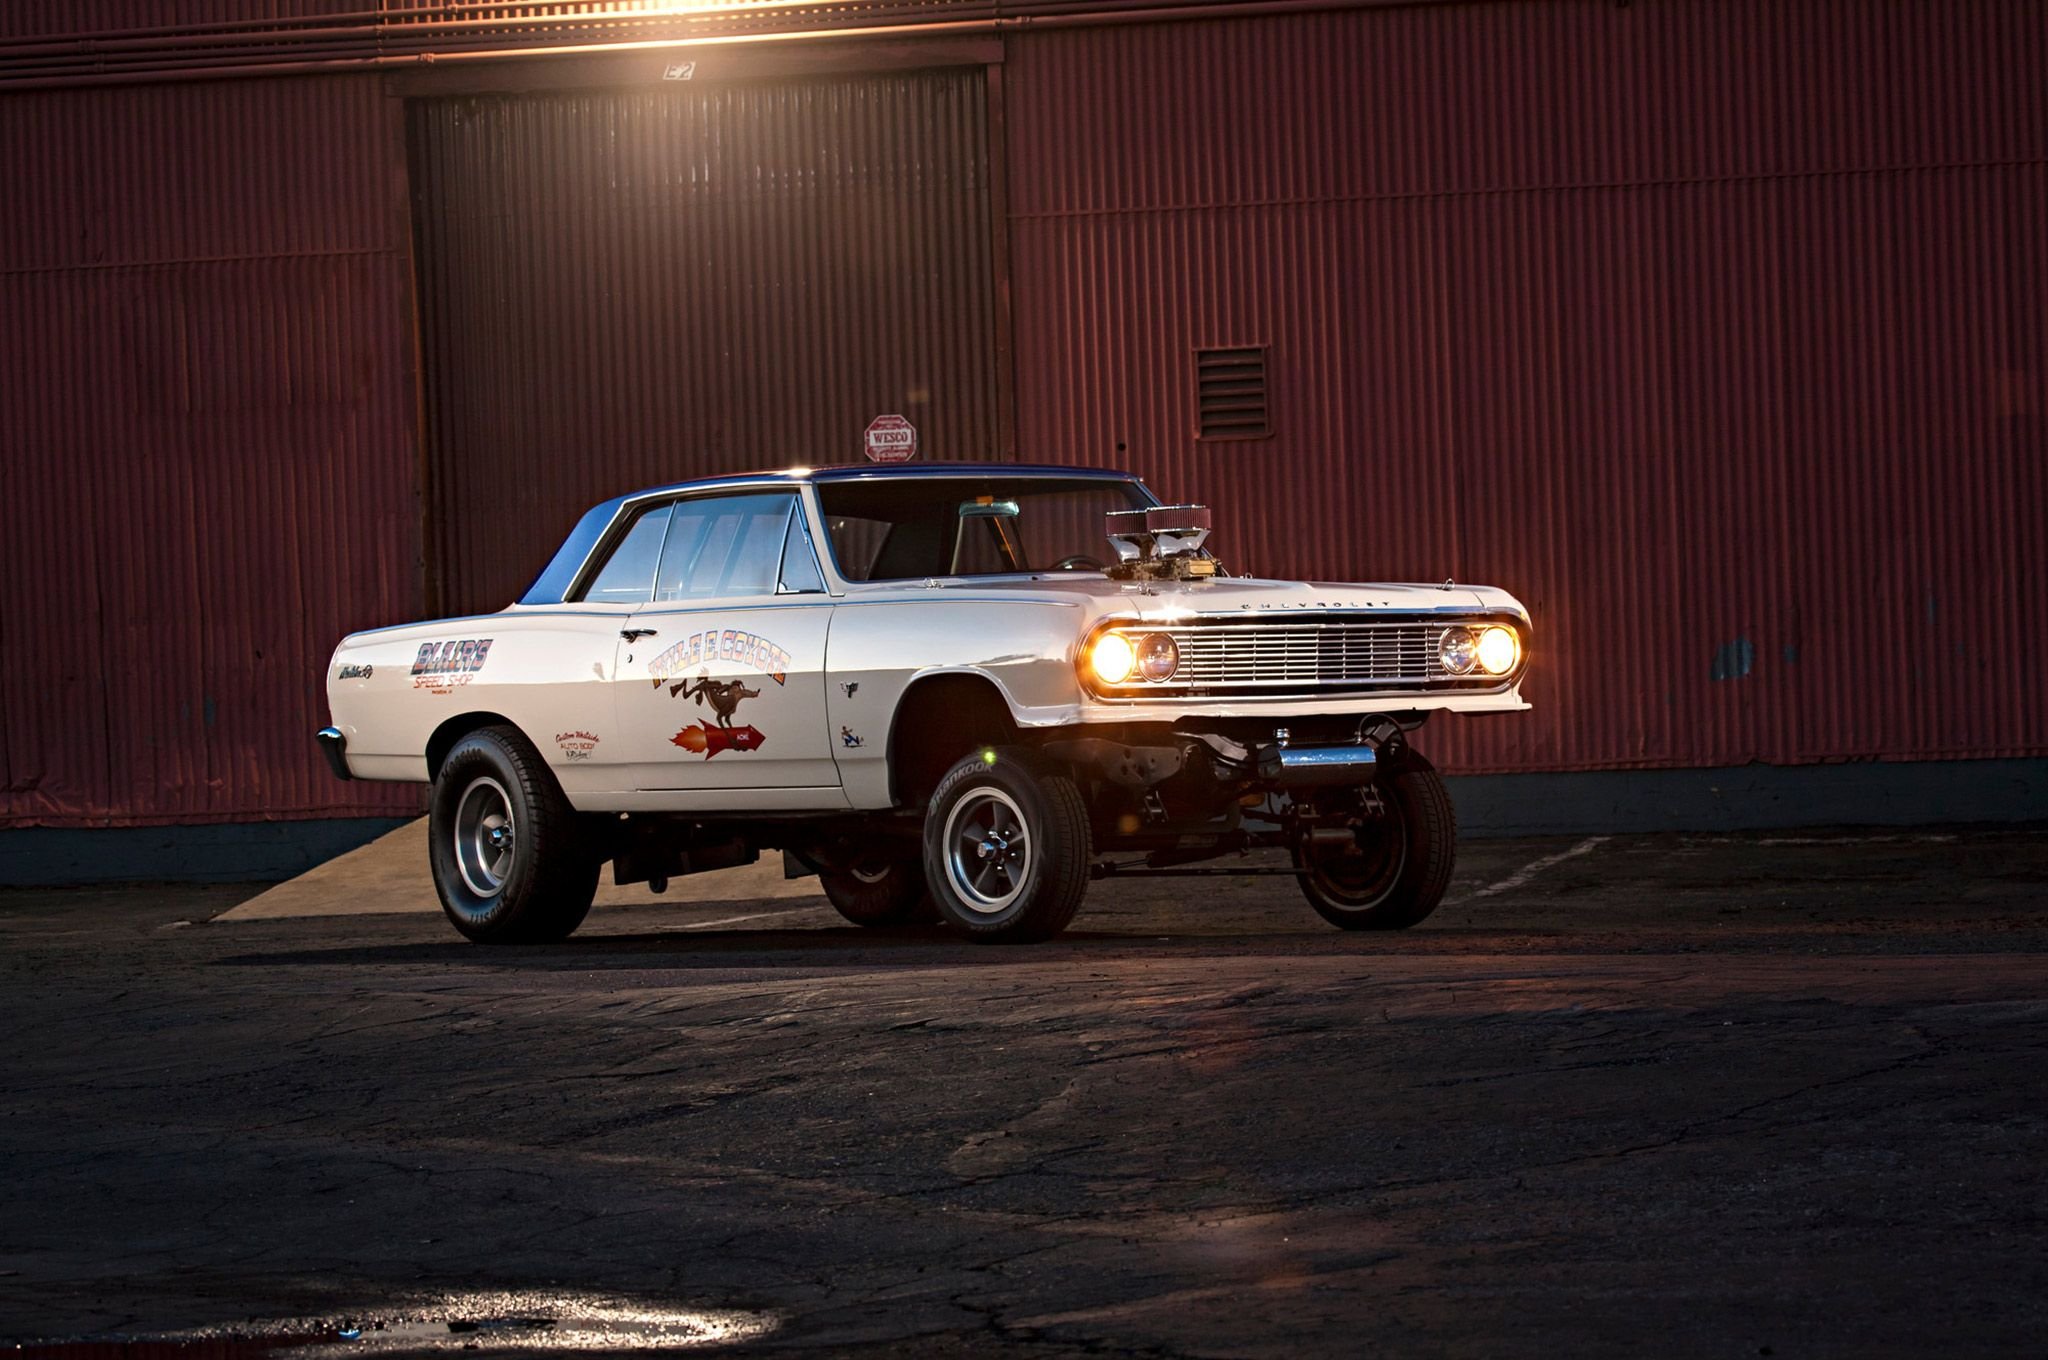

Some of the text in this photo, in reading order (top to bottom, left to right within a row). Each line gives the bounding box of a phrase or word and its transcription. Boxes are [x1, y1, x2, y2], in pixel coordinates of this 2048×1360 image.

[873, 431, 908, 444] WESCO
[410, 638, 494, 676] BLAIR'S
[720, 629, 792, 687] COYOTE
[413, 674, 474, 689] SPEED SHOP
